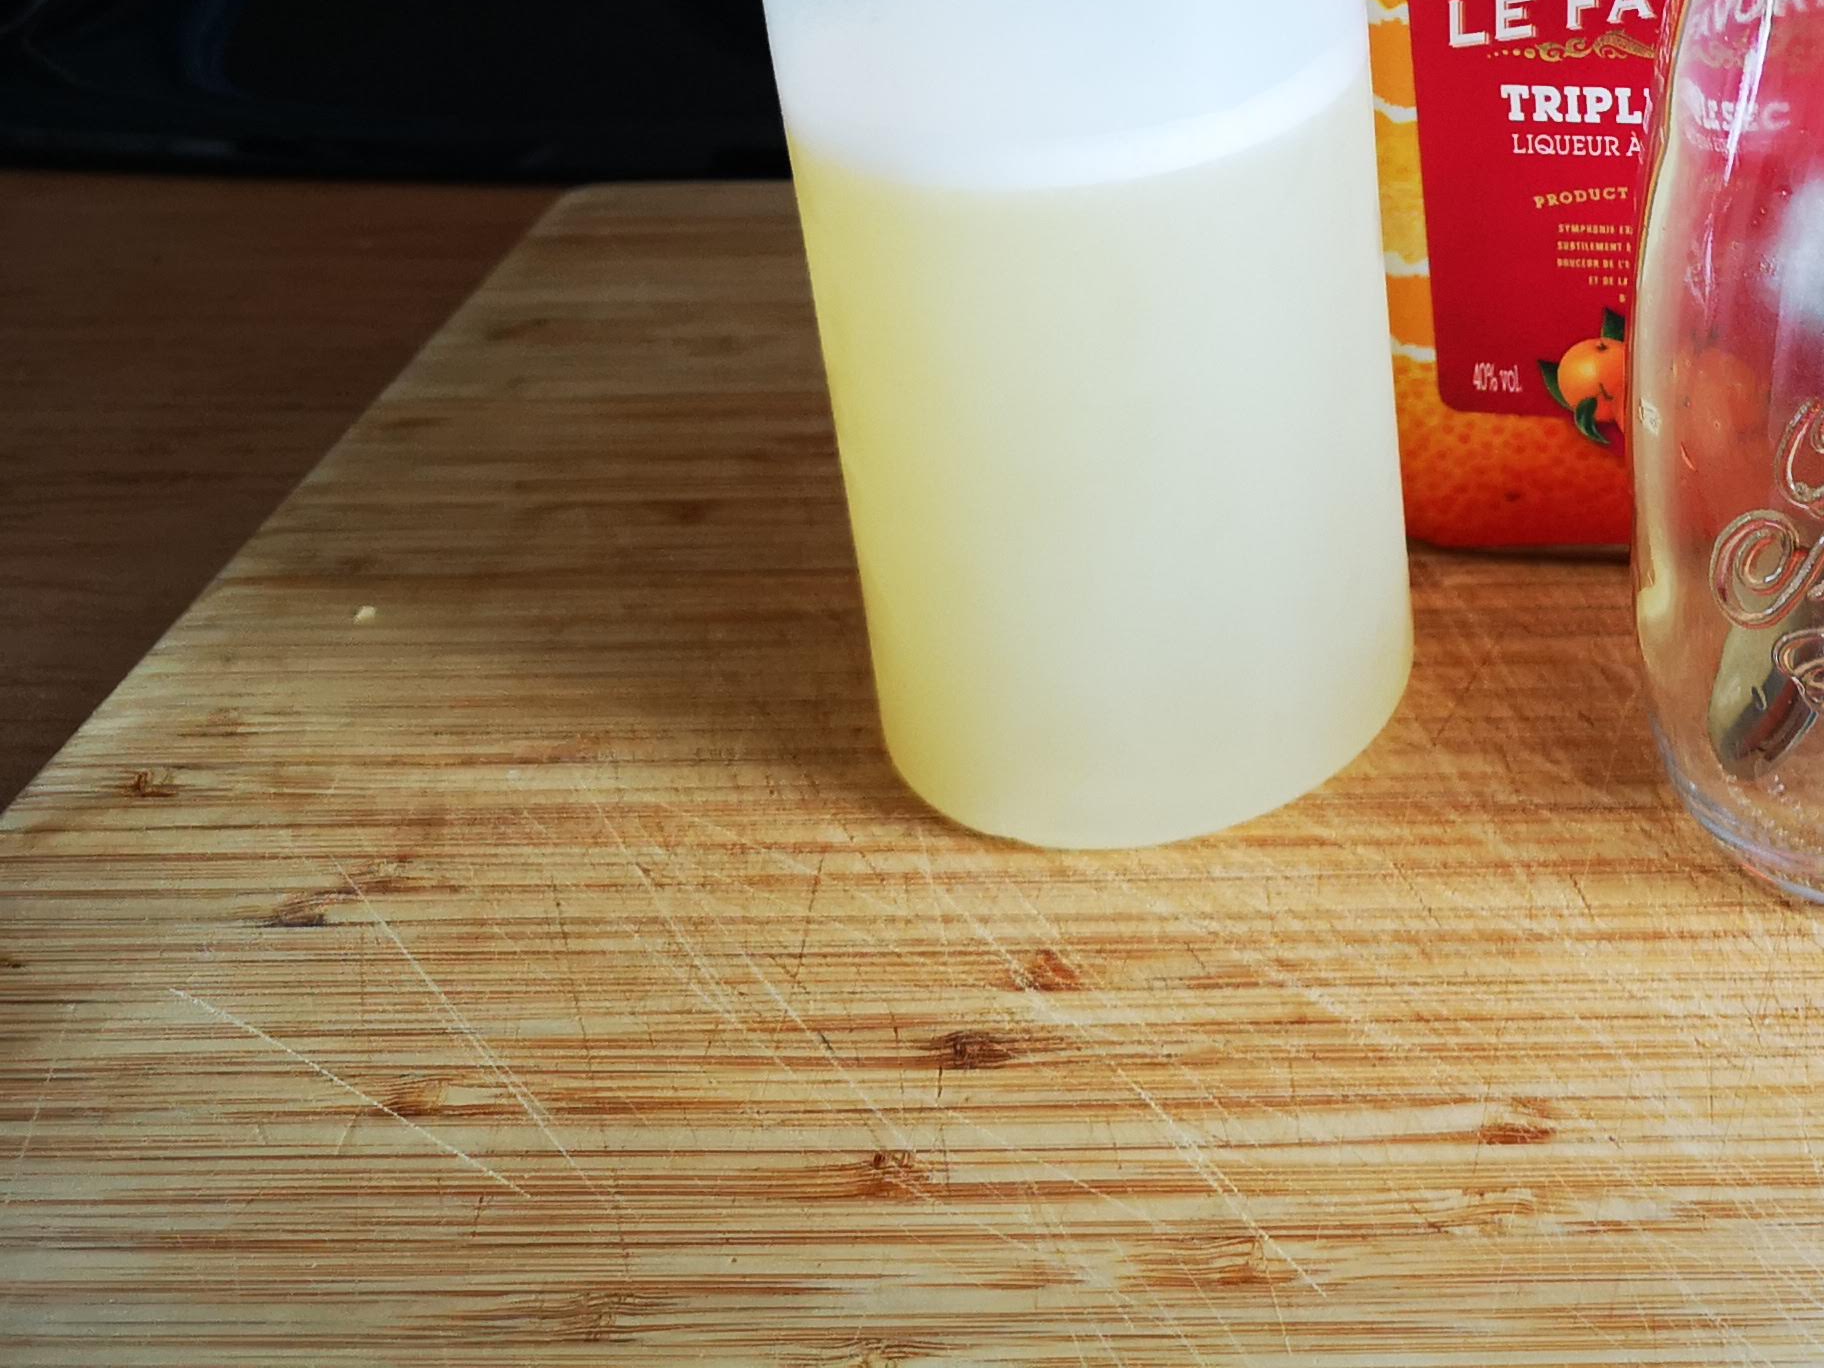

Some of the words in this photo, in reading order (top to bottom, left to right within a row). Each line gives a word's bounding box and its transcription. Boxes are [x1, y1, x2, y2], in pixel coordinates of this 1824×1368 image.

[1500, 84, 1650, 124] TRIPL
[1511, 133, 1620, 157] LIQUEUR
[1473, 362, 1498, 391] 40%
